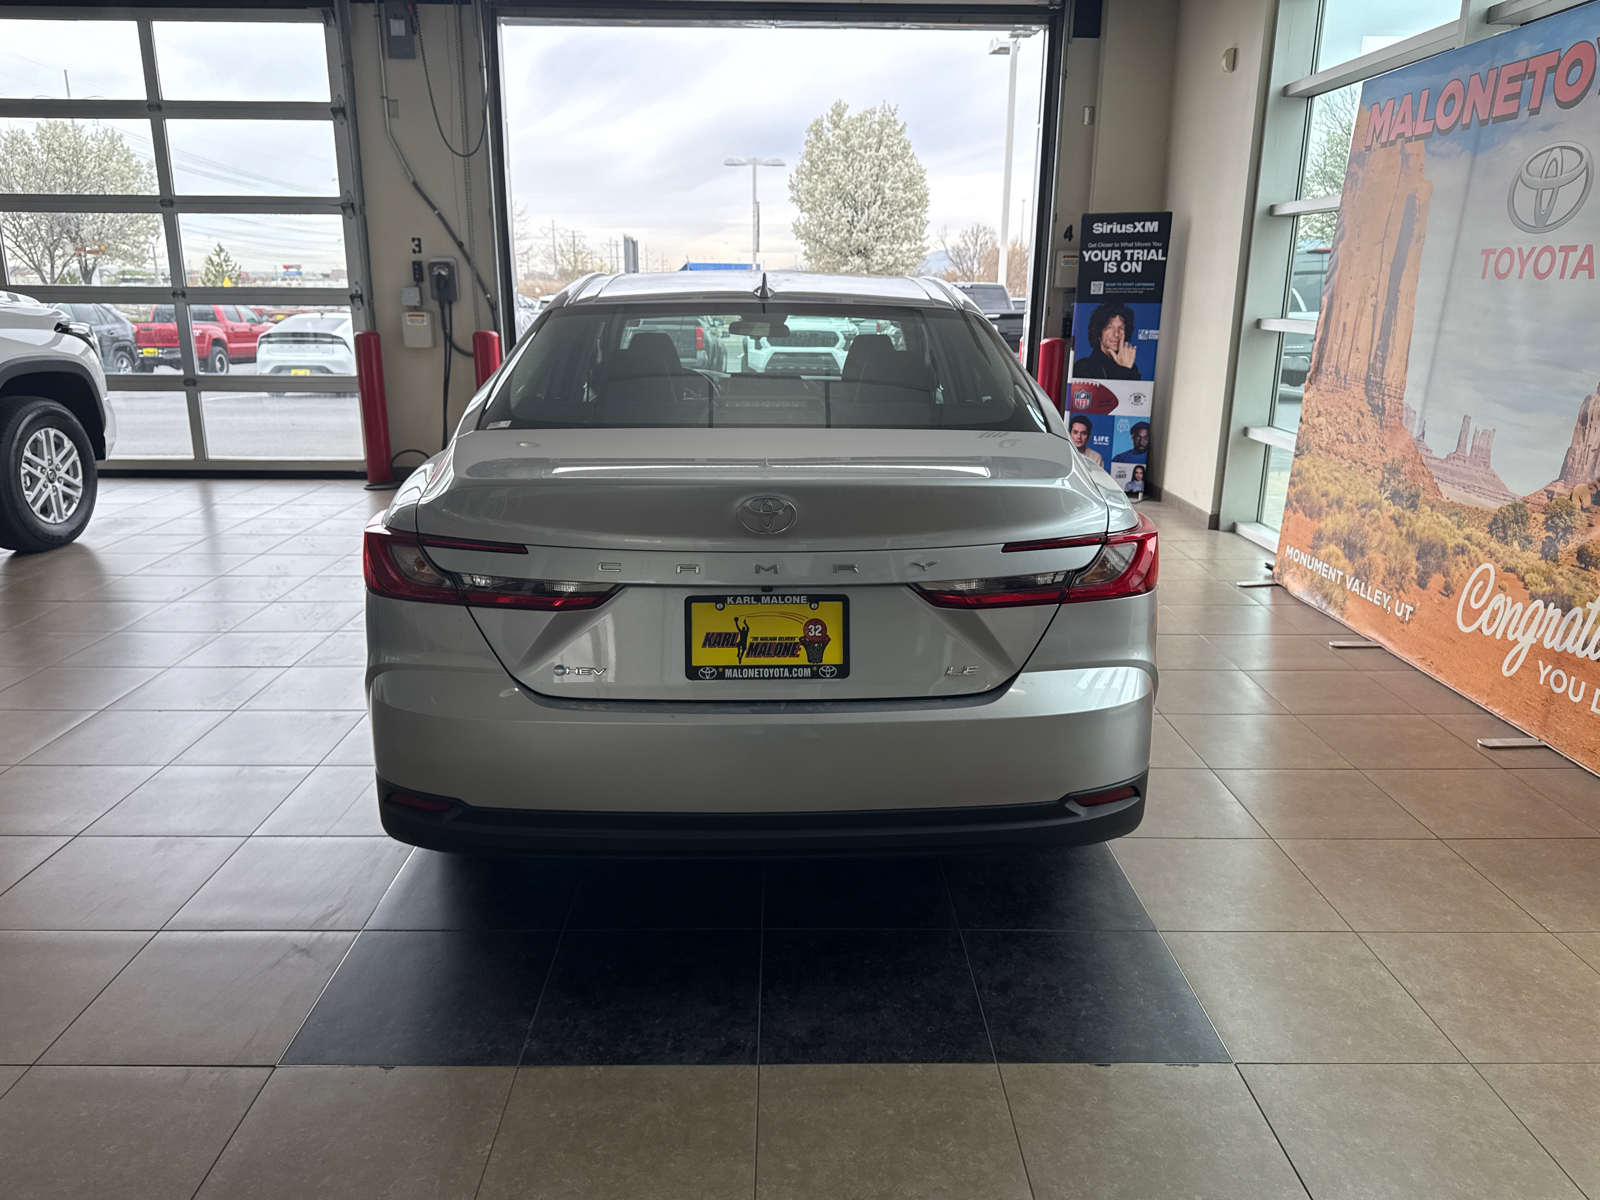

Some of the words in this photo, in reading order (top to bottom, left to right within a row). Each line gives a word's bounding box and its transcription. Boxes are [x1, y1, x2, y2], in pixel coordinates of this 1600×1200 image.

[1364, 36, 1600, 152] MALONETO
[1064, 225, 1074, 242] 4
[1093, 222, 1159, 233] SiriusXM
[411, 237, 422, 254] 3
[1082, 249, 1121, 262] YOUR
[1124, 249, 1166, 261] TRIAL
[1103, 262, 1117, 273] IS
[1120, 261, 1142, 273] ON
[1480, 244, 1596, 281] TOYOTA
[1074, 398, 1090, 409] NFL
[1284, 544, 1344, 585] MONUMENT
[1346, 574, 1392, 614] VALLEY,
[1394, 599, 1414, 622] UT
[727, 596, 757, 604] KARL
[762, 596, 807, 604] MALONE
[808, 624, 822, 637] 32
[702, 632, 740, 648] KARL
[745, 641, 801, 658] MALONE
[566, 666, 606, 676] HEV
[725, 667, 811, 678] MALONETOYOTA.COM
[944, 665, 979, 677] LE
[1538, 660, 1586, 703] YOU
